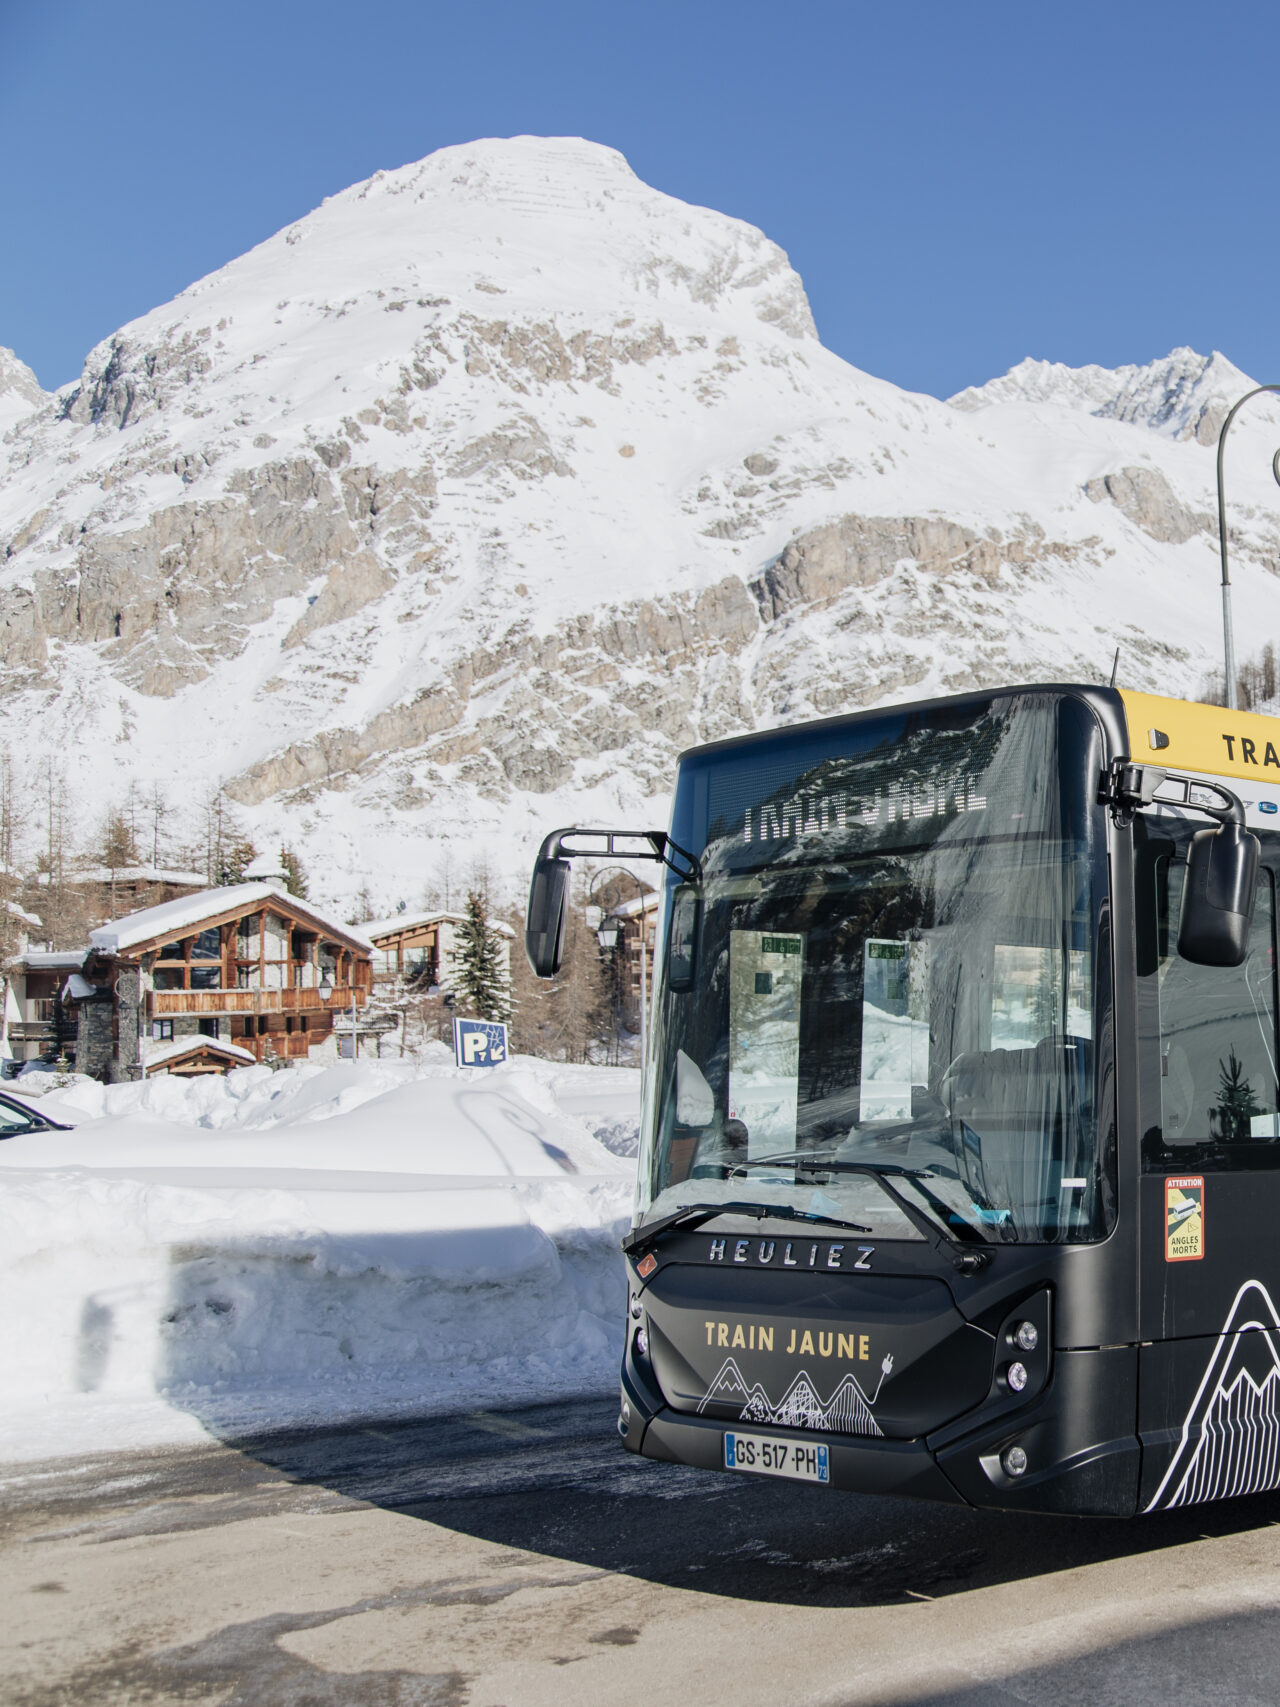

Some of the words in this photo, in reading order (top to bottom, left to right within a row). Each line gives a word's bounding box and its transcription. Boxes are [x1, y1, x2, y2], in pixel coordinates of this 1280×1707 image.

[1167, 1179, 1202, 1188] ATTENTION
[1171, 1236, 1199, 1245] ANGLES
[709, 1239, 876, 1269] HEULIEZ
[1172, 1245, 1198, 1255] MORTS
[705, 1321, 774, 1351] TRAIN
[787, 1328, 870, 1361] JAUNE
[818, 1465, 828, 1478] 73
